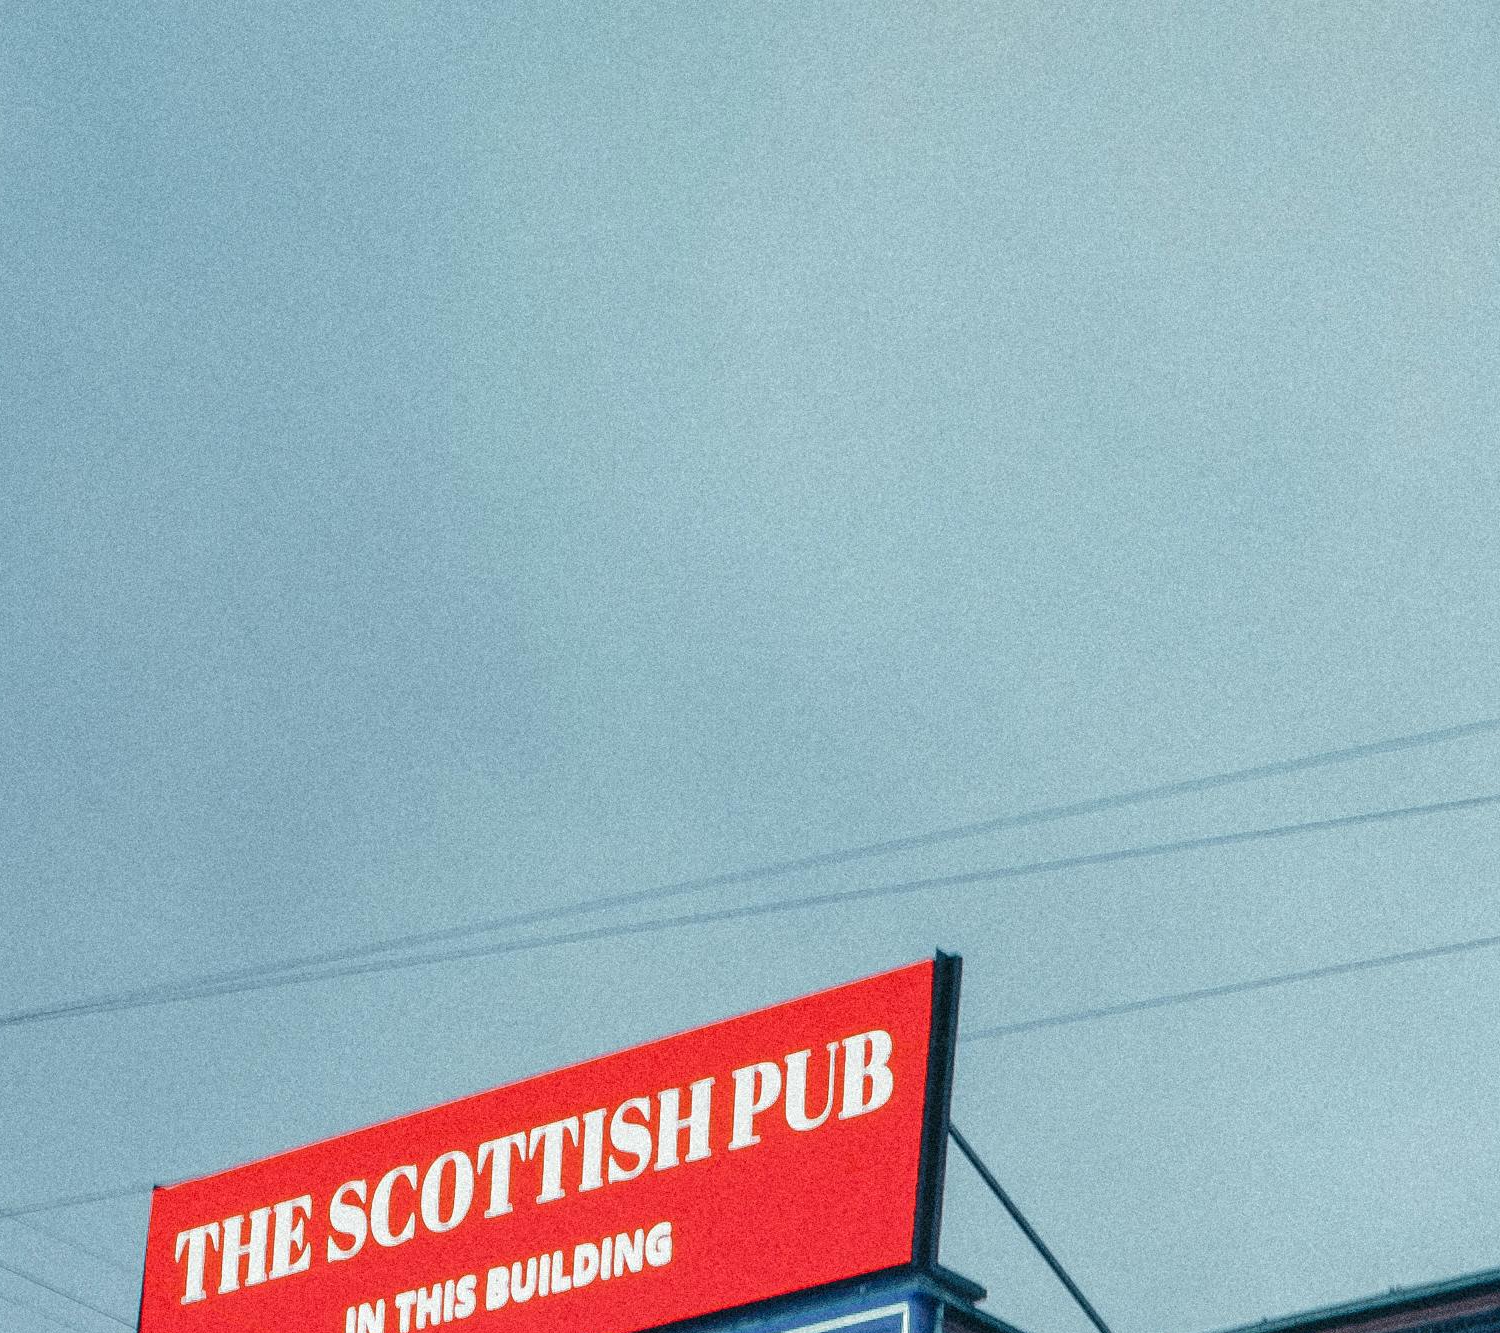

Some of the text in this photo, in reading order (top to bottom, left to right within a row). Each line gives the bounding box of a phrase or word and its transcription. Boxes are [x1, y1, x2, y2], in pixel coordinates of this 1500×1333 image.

[175, 1029, 895, 1305] THE SCOTTISH PUB
[394, 1282, 477, 1333] THIS
[485, 1222, 673, 1311] BUILDING
